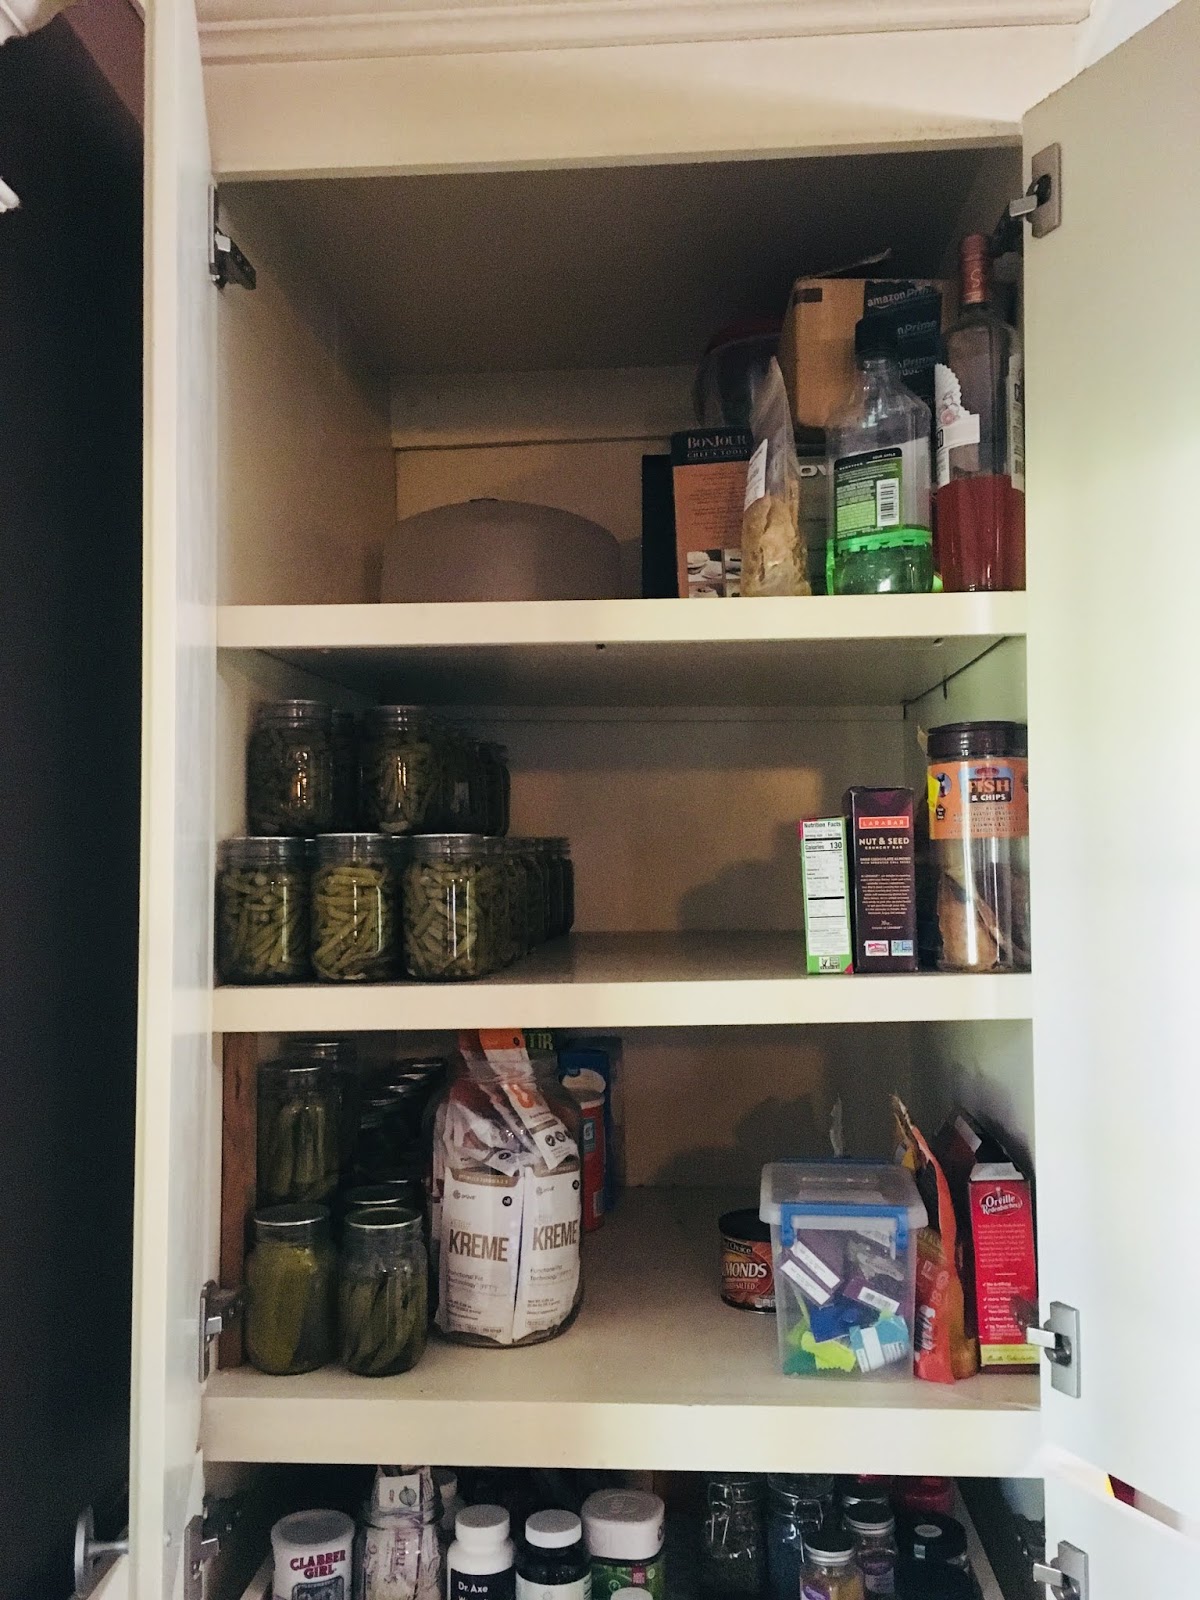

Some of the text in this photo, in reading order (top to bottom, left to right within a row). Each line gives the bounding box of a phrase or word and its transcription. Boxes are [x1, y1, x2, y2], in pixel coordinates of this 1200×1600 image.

[968, 780, 1010, 793] FISH
[830, 841, 843, 849] 130
[859, 837, 910, 846] NUT & SEED
[985, 1194, 1016, 1208] Orville
[532, 1219, 579, 1251] KREME
[449, 1228, 509, 1262] KREME
[723, 1262, 768, 1278] MONDS
[290, 1549, 346, 1571] CLABBER
[303, 1564, 335, 1579] GIRL
[470, 1583, 489, 1594] Axe
